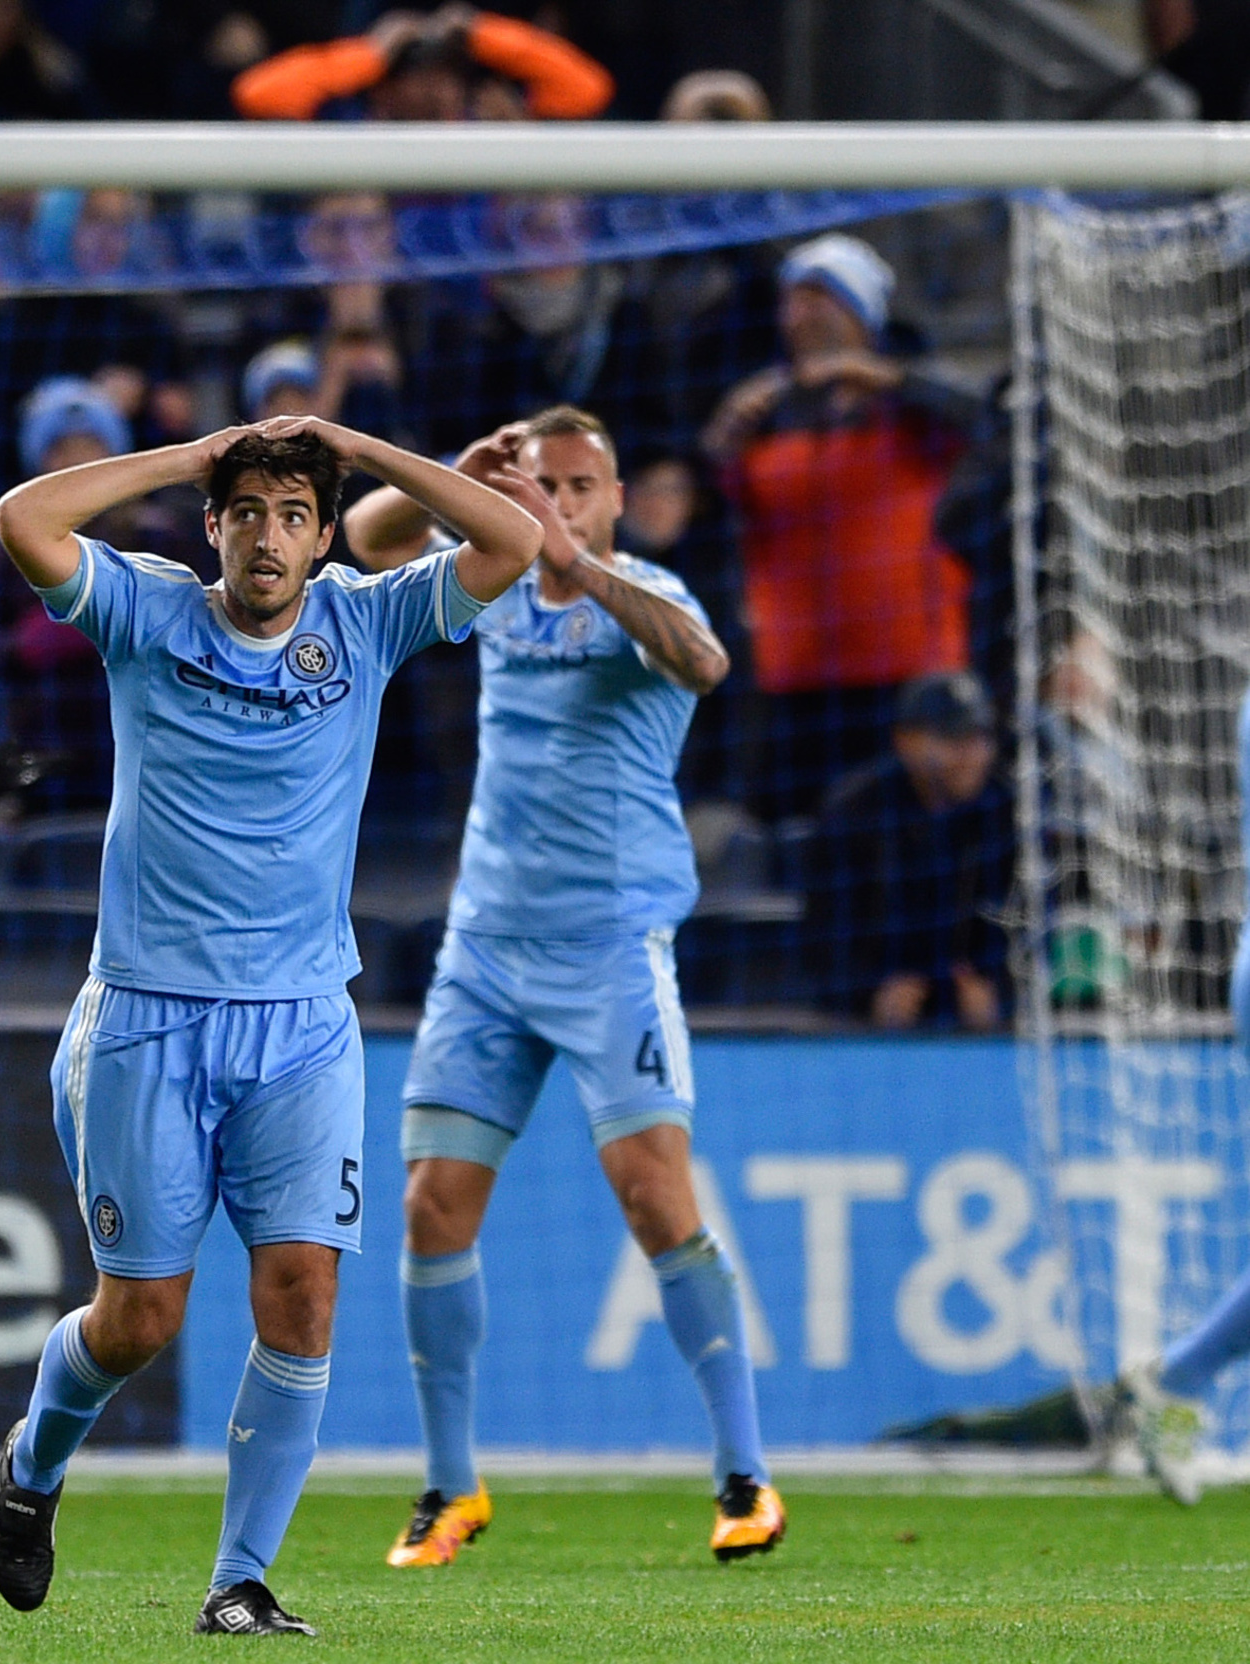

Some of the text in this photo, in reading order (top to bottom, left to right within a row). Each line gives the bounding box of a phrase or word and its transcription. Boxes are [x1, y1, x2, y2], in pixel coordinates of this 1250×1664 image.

[201, 696, 325, 727] AIRWAS
[636, 1031, 665, 1087] 4
[335, 1157, 361, 1227] 5
